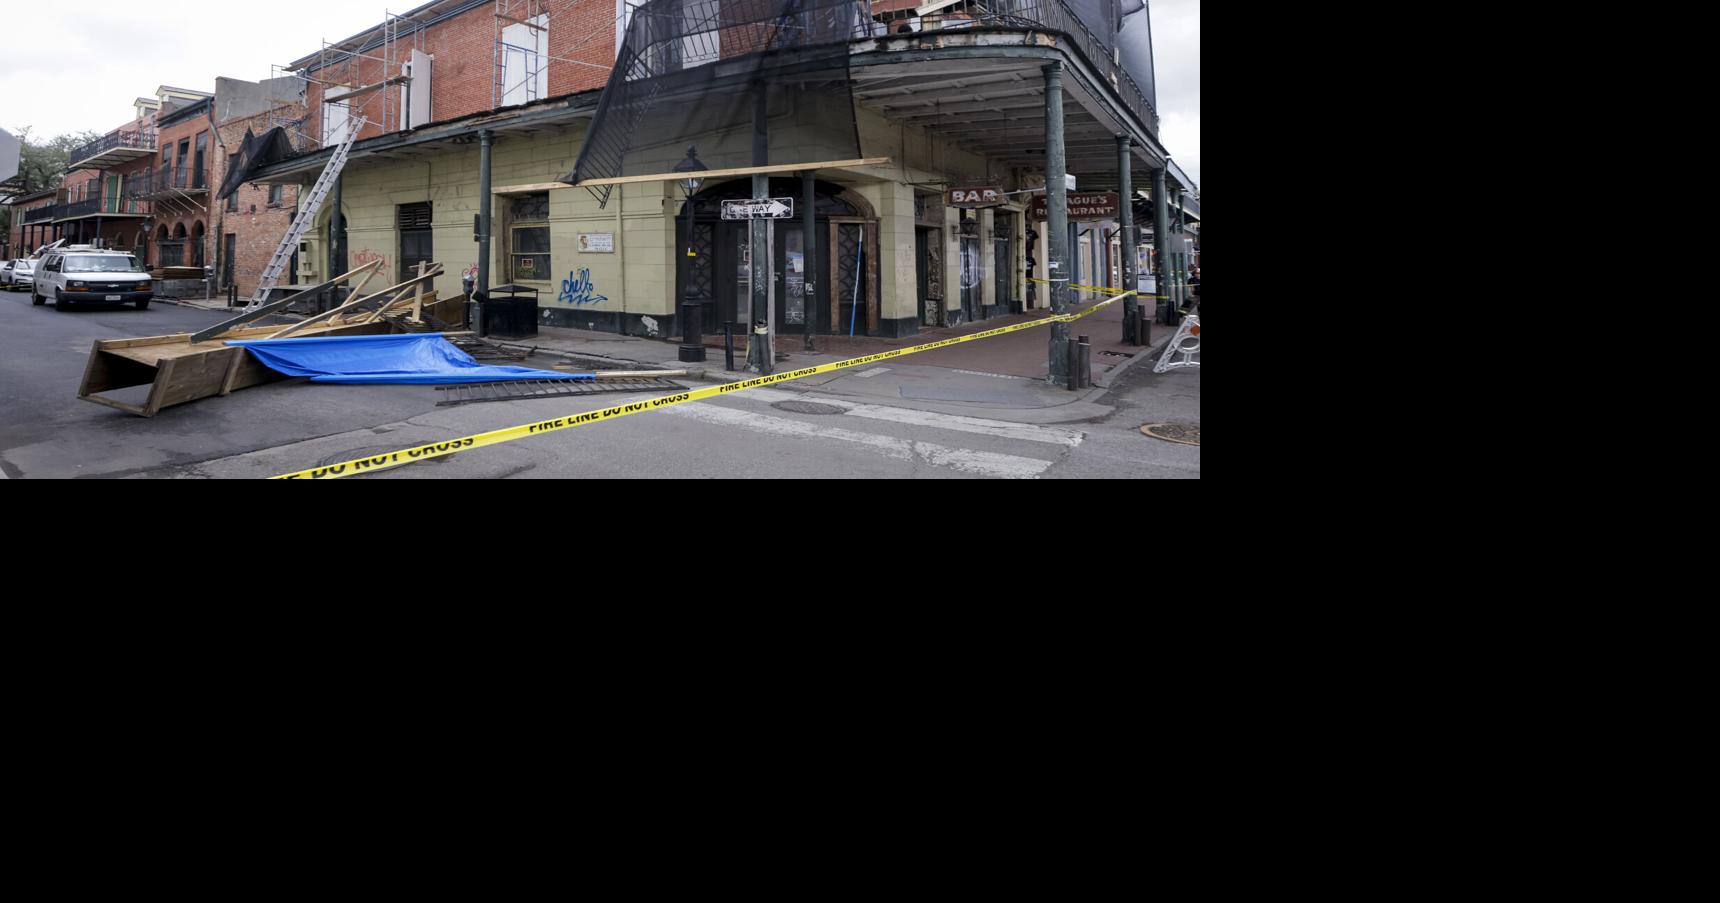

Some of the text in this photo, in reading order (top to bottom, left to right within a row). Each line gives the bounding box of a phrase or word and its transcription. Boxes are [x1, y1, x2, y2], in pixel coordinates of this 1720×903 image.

[952, 190, 998, 202] BAR
[752, 204, 771, 213] WAY
[742, 379, 761, 388] LINE
[567, 412, 600, 425] LINE
